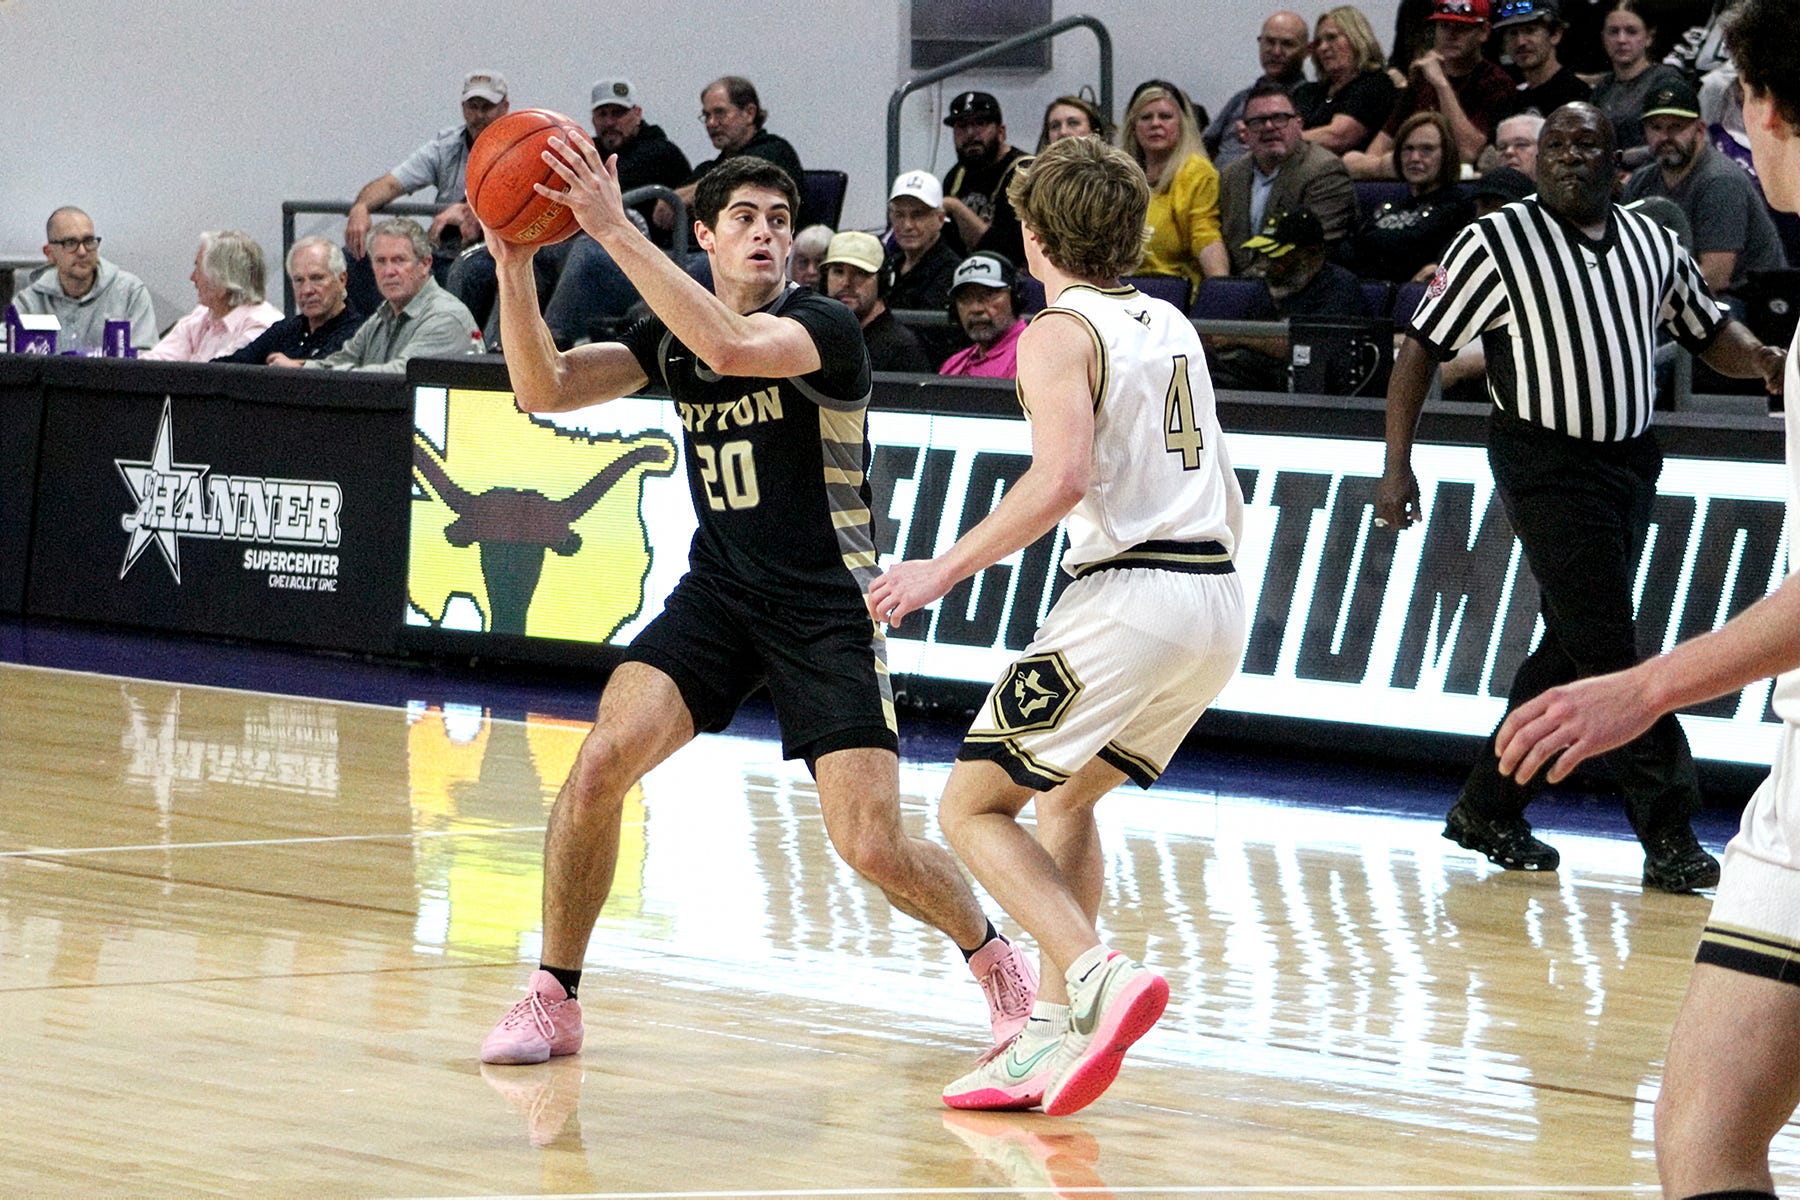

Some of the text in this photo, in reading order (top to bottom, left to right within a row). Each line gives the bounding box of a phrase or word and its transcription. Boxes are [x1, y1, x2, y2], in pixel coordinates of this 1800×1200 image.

[1163, 354, 1204, 471] 4
[142, 470, 343, 548] HANNER
[695, 439, 760, 512] 20
[243, 548, 339, 576] SUPERCENTER
